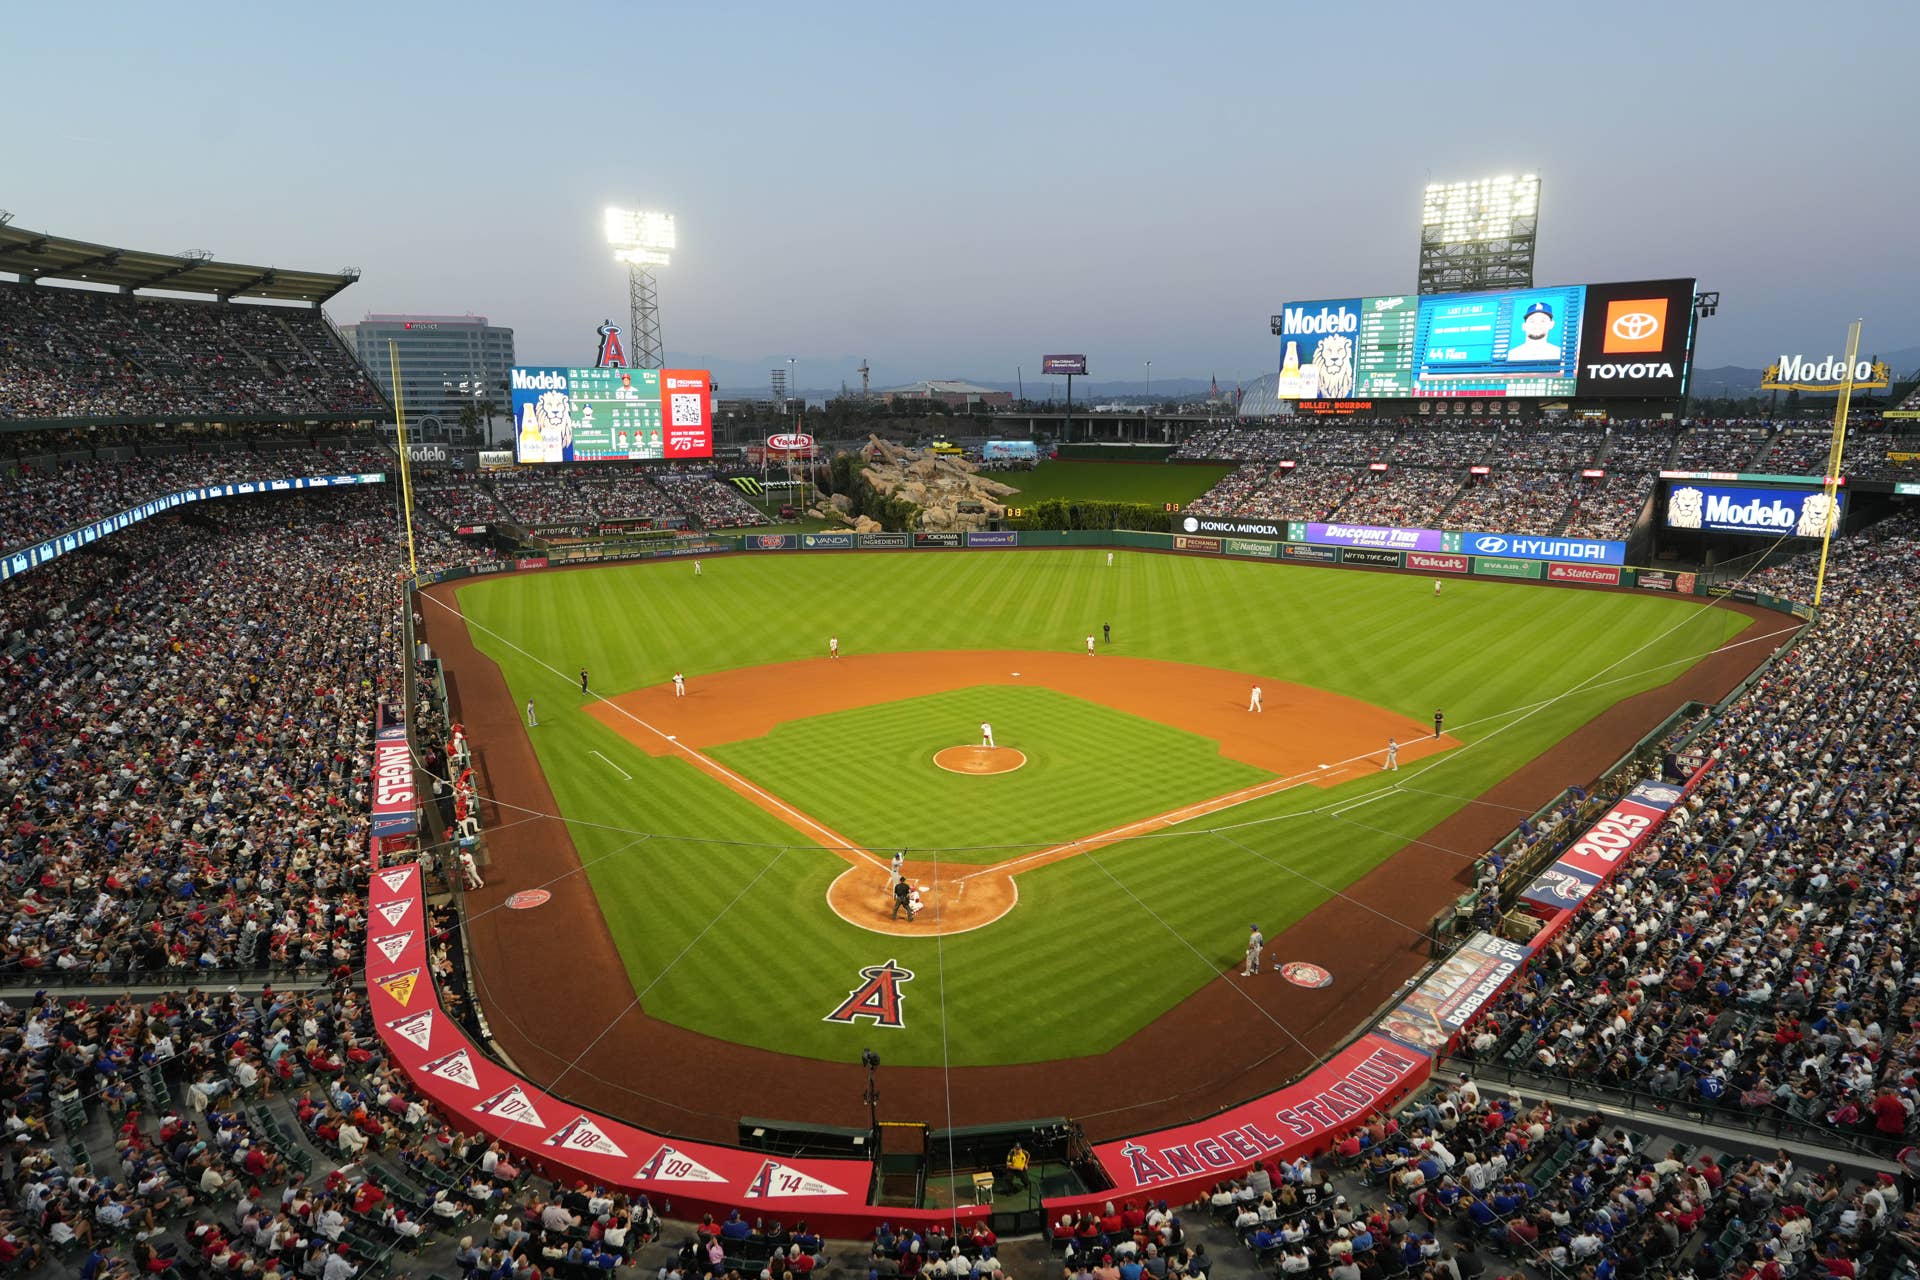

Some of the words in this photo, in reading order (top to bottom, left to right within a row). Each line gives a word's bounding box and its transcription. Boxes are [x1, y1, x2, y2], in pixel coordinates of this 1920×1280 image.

[1283, 306, 1358, 334] Modelo
[1586, 363, 1674, 379] TOYOTA
[1777, 354, 1872, 381] Modelo
[511, 369, 567, 389] Modelo
[670, 437, 692, 450] $75
[1705, 495, 1795, 527] Modelo
[1200, 521, 1236, 532] KONICA
[1237, 525, 1278, 535] MINOLTA
[1325, 526, 1389, 540] DISCOUNT
[1390, 530, 1420, 542] TIRE
[1187, 539, 1218, 547] PECHANGA
[1240, 542, 1273, 552] National
[1513, 540, 1606, 559] HYUNDAI
[1344, 551, 1365, 559] NITTO
[1366, 554, 1398, 562] TIRE.COM
[1411, 556, 1464, 569] Yakult
[377, 746, 415, 805] ANGELS
[1574, 812, 1652, 862] 2025
[1500, 941, 1523, 961] 8TH
[1446, 962, 1516, 1026] BOBBLEHEAD
[442, 1060, 469, 1078] '05
[1276, 1047, 1415, 1137] STADIUM
[500, 1097, 528, 1115] '07
[572, 1128, 601, 1149] '08
[1121, 1123, 1284, 1187] ANGEL
[664, 1158, 693, 1178] '09
[779, 1173, 803, 1193] '14
[1306, 1194, 1317, 1205] 42
